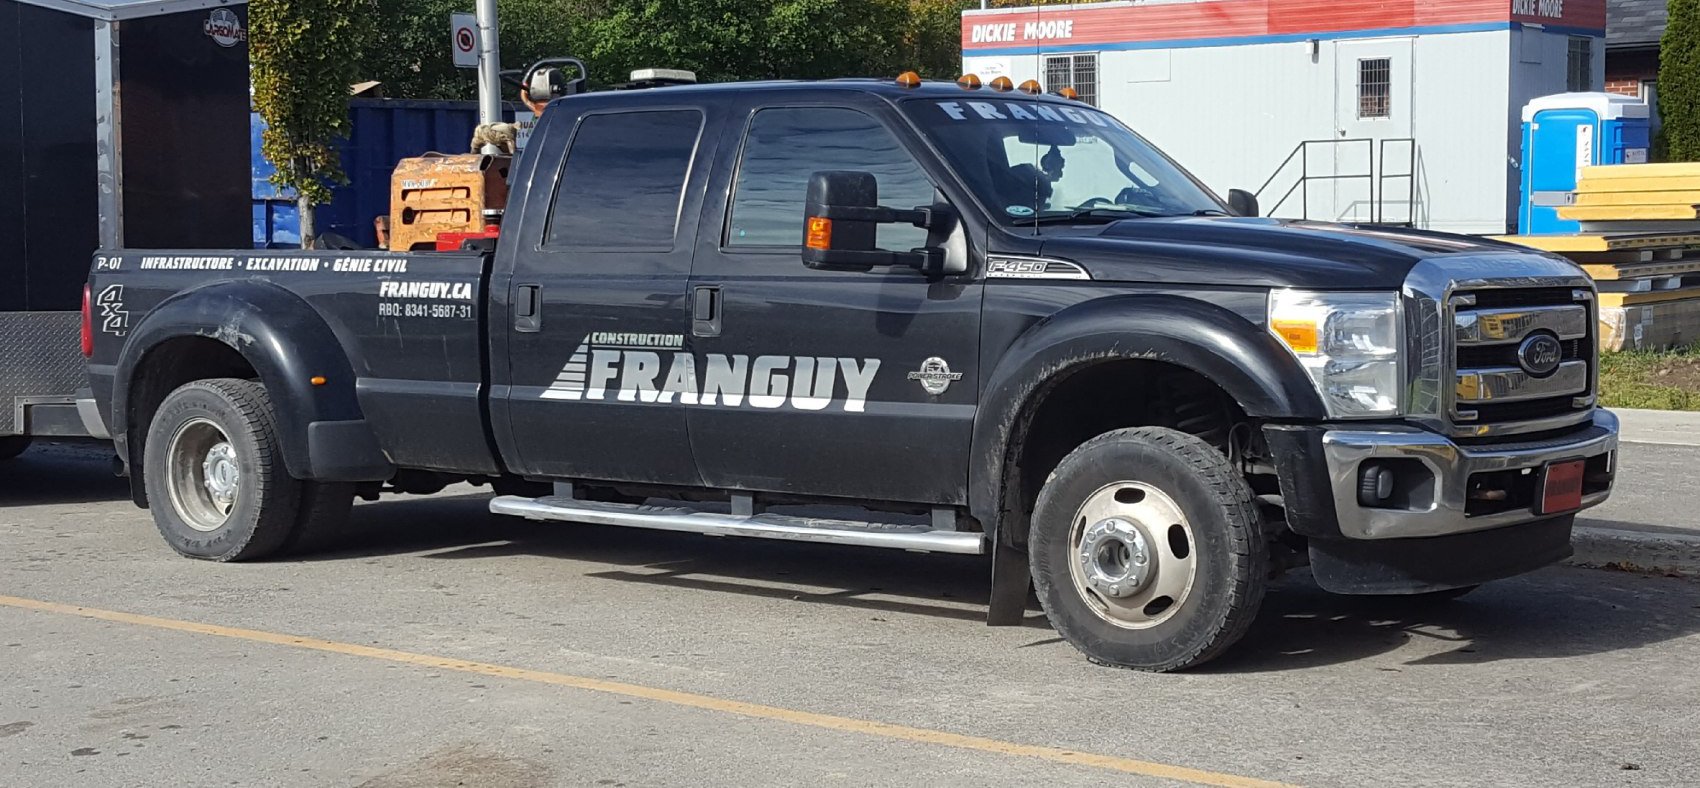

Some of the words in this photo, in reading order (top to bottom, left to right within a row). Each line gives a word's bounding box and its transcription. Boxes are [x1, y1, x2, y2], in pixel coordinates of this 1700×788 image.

[1512, 0, 1536, 16] DICKIE
[1538, 0, 1563, 18] MOORE
[971, 23, 1017, 43] DICKIE
[1023, 20, 1074, 40] MOORE
[97, 256, 122, 270] P-01
[140, 256, 235, 270] INFRASTRUCTURE
[246, 257, 320, 272] EXCAVATION
[333, 257, 371, 272] GÉNIE
[373, 259, 407, 273] CIVIL
[988, 260, 1048, 273] F-450
[379, 281, 472, 300] FRANGUY.CA
[378, 303, 403, 317] RBQ:
[405, 303, 472, 319] 8341-5687-31
[591, 331, 684, 347] CONSTRUCTION
[1533, 341, 1557, 364] Ford
[585, 349, 881, 413] FRANGUY
